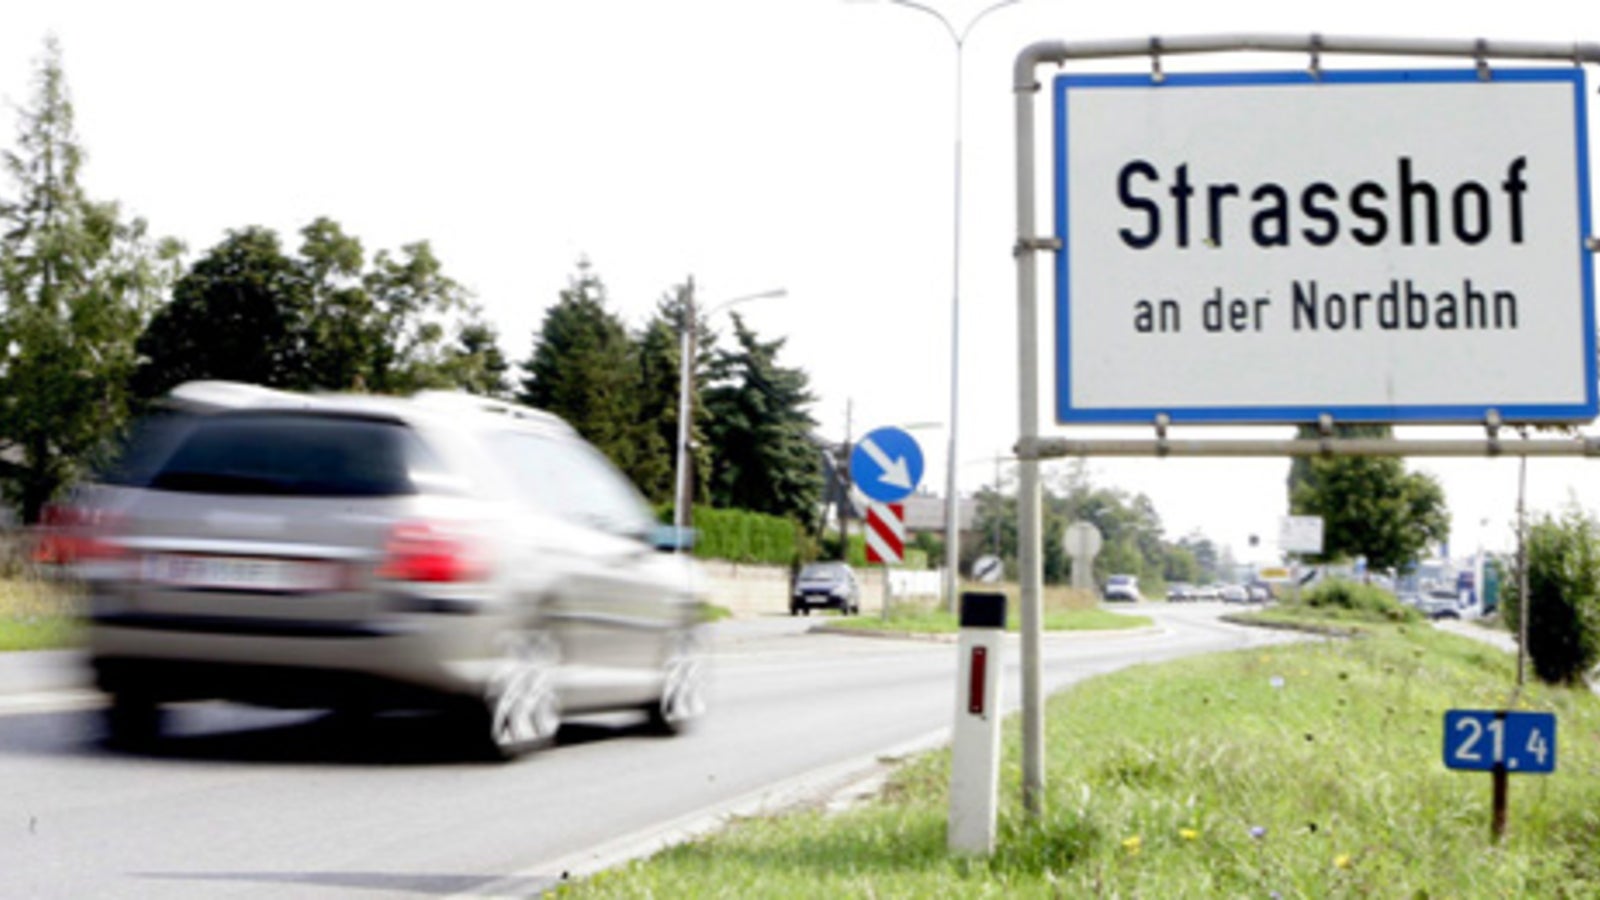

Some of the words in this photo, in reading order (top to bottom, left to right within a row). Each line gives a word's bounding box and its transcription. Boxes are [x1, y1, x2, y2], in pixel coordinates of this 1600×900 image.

[1117, 156, 1529, 249] Strasshof
[1134, 299, 1181, 333] an
[1203, 287, 1271, 333] der
[1291, 279, 1519, 331] Nordbahn
